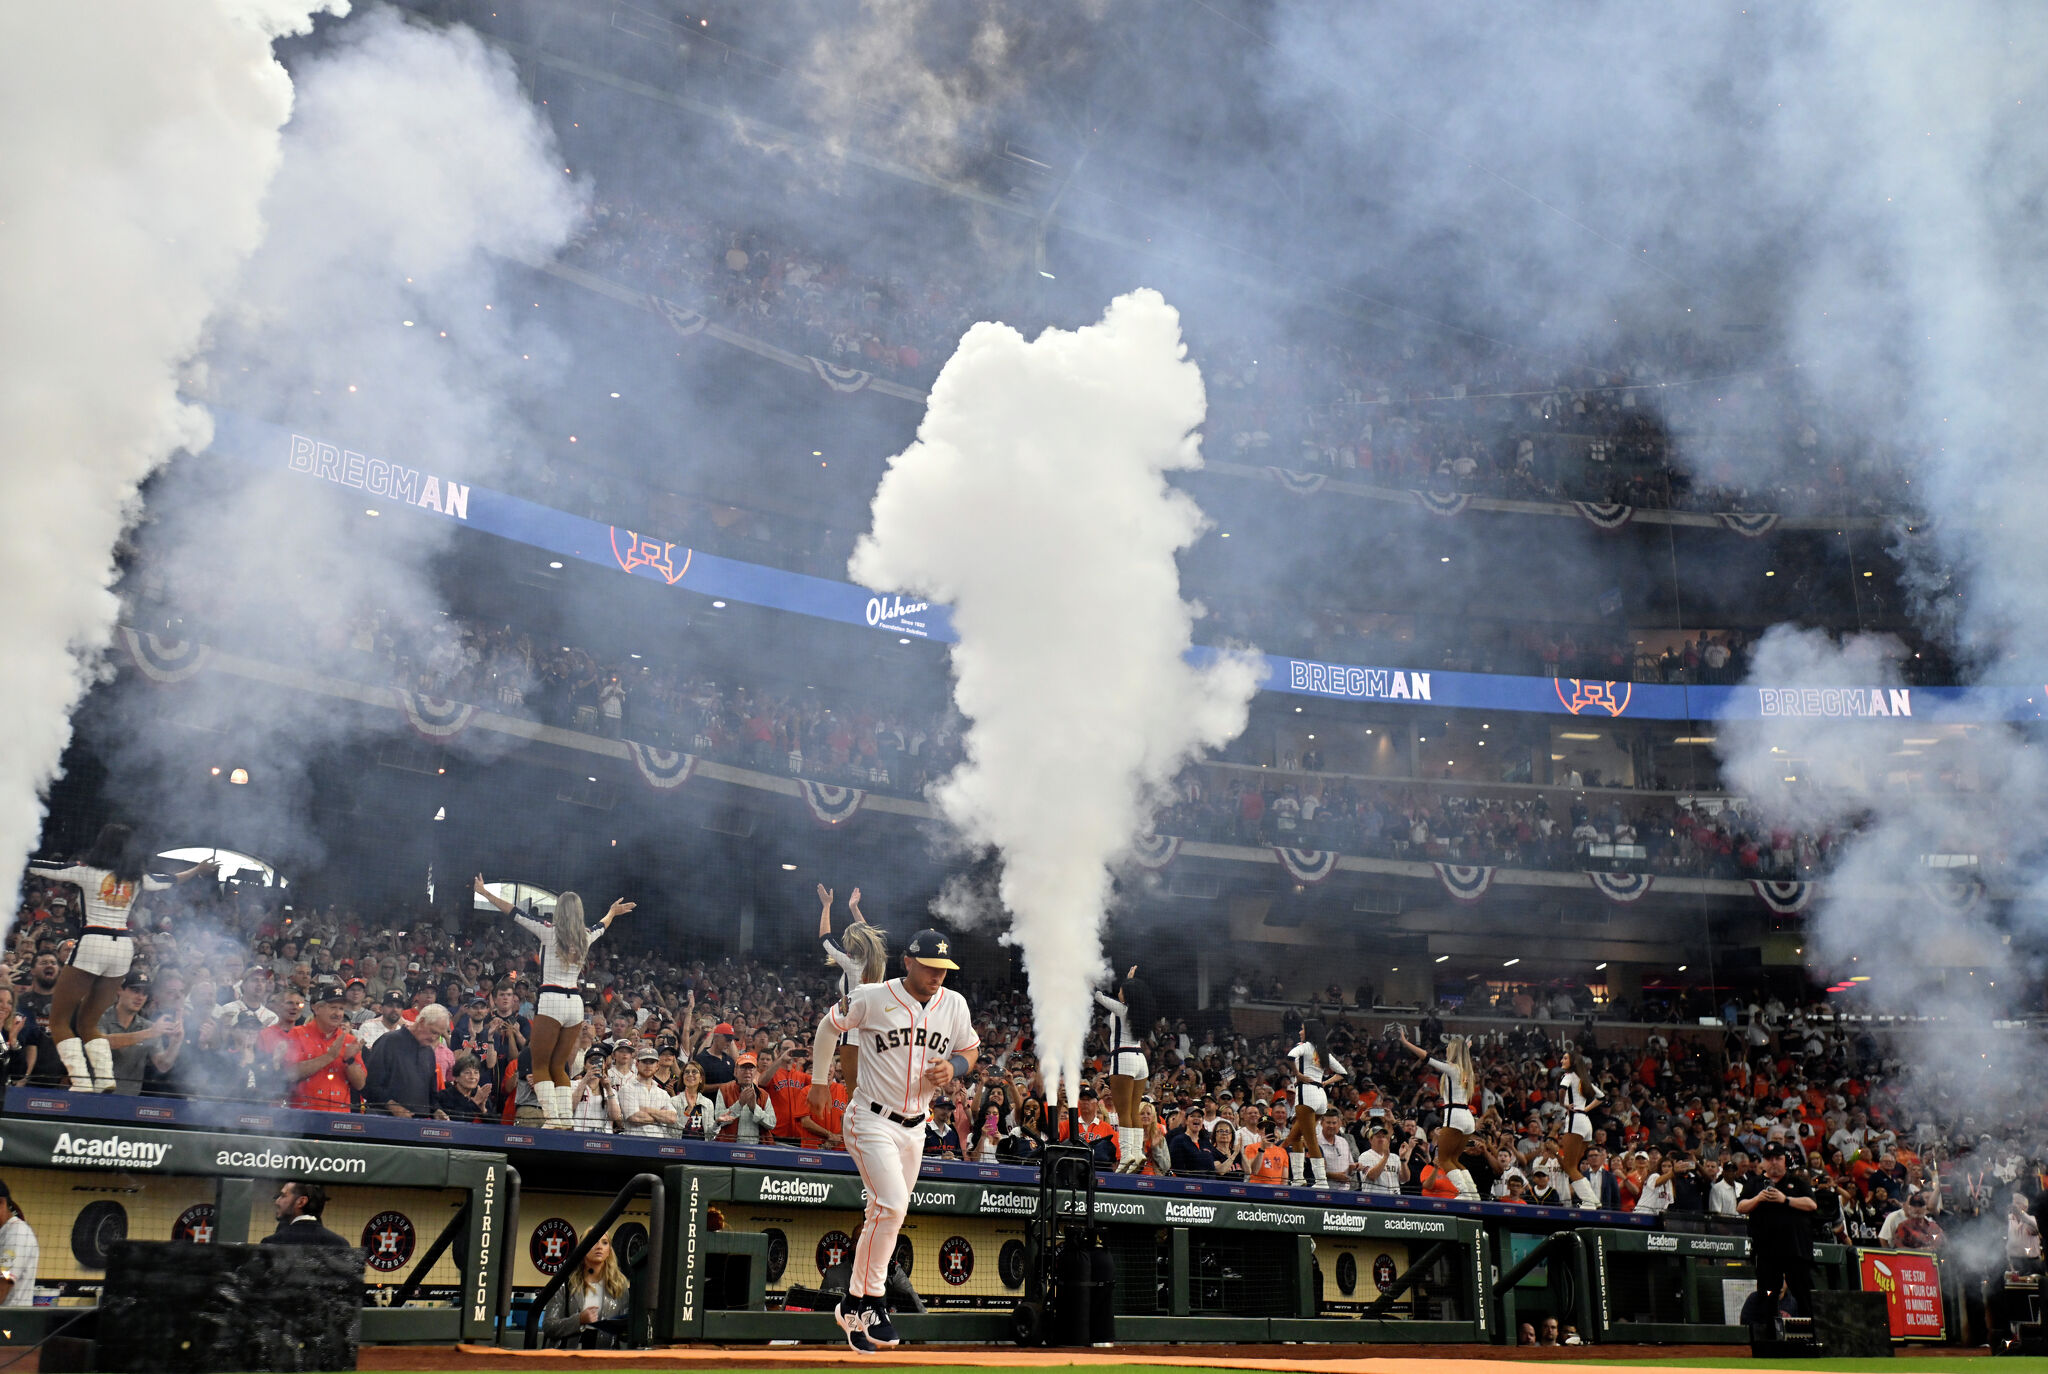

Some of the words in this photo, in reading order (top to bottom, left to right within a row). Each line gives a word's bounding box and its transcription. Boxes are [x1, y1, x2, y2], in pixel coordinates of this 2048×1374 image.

[288, 434, 470, 519] BREGMAN
[866, 596, 928, 625] Olshan
[1290, 660, 1431, 700] BREGMAN
[1759, 689, 1912, 717] BREGMAN
[875, 1028, 950, 1055] ASTROS
[53, 1132, 169, 1166] Academy
[51, 1155, 155, 1168] SPORTS+OUTDOORS
[216, 1149, 366, 1174] academy.com
[760, 1175, 831, 1201] Academy
[759, 1194, 822, 1203] SPORTS+OUTDOORS
[861, 1188, 956, 1206] amy.com
[980, 1190, 1038, 1212] Academy
[182, 1208, 215, 1224] HOUST
[1064, 1200, 1145, 1216] acaemy.com
[1165, 1201, 1215, 1222] Academy
[371, 1214, 410, 1231] HOUSTON
[1237, 1209, 1305, 1226] academy.com
[1323, 1211, 1366, 1230] Academy
[1384, 1218, 1444, 1233] academy.com
[537, 1221, 573, 1237] HOUSTON
[1648, 1234, 1678, 1251] Academy
[1691, 1239, 1734, 1252] academy.com
[369, 1254, 405, 1269] ASTROS
[1874, 1267, 1890, 1291] TAKE
[1901, 1270, 1912, 1281] THE
[1912, 1270, 1926, 1282] STAY
[1903, 1284, 1910, 1295] IN
[1926, 1286, 1937, 1298] CAR
[1905, 1299, 1911, 1310] 10
[1912, 1299, 1933, 1311] MINUTE
[1907, 1313, 1916, 1325] OIL
